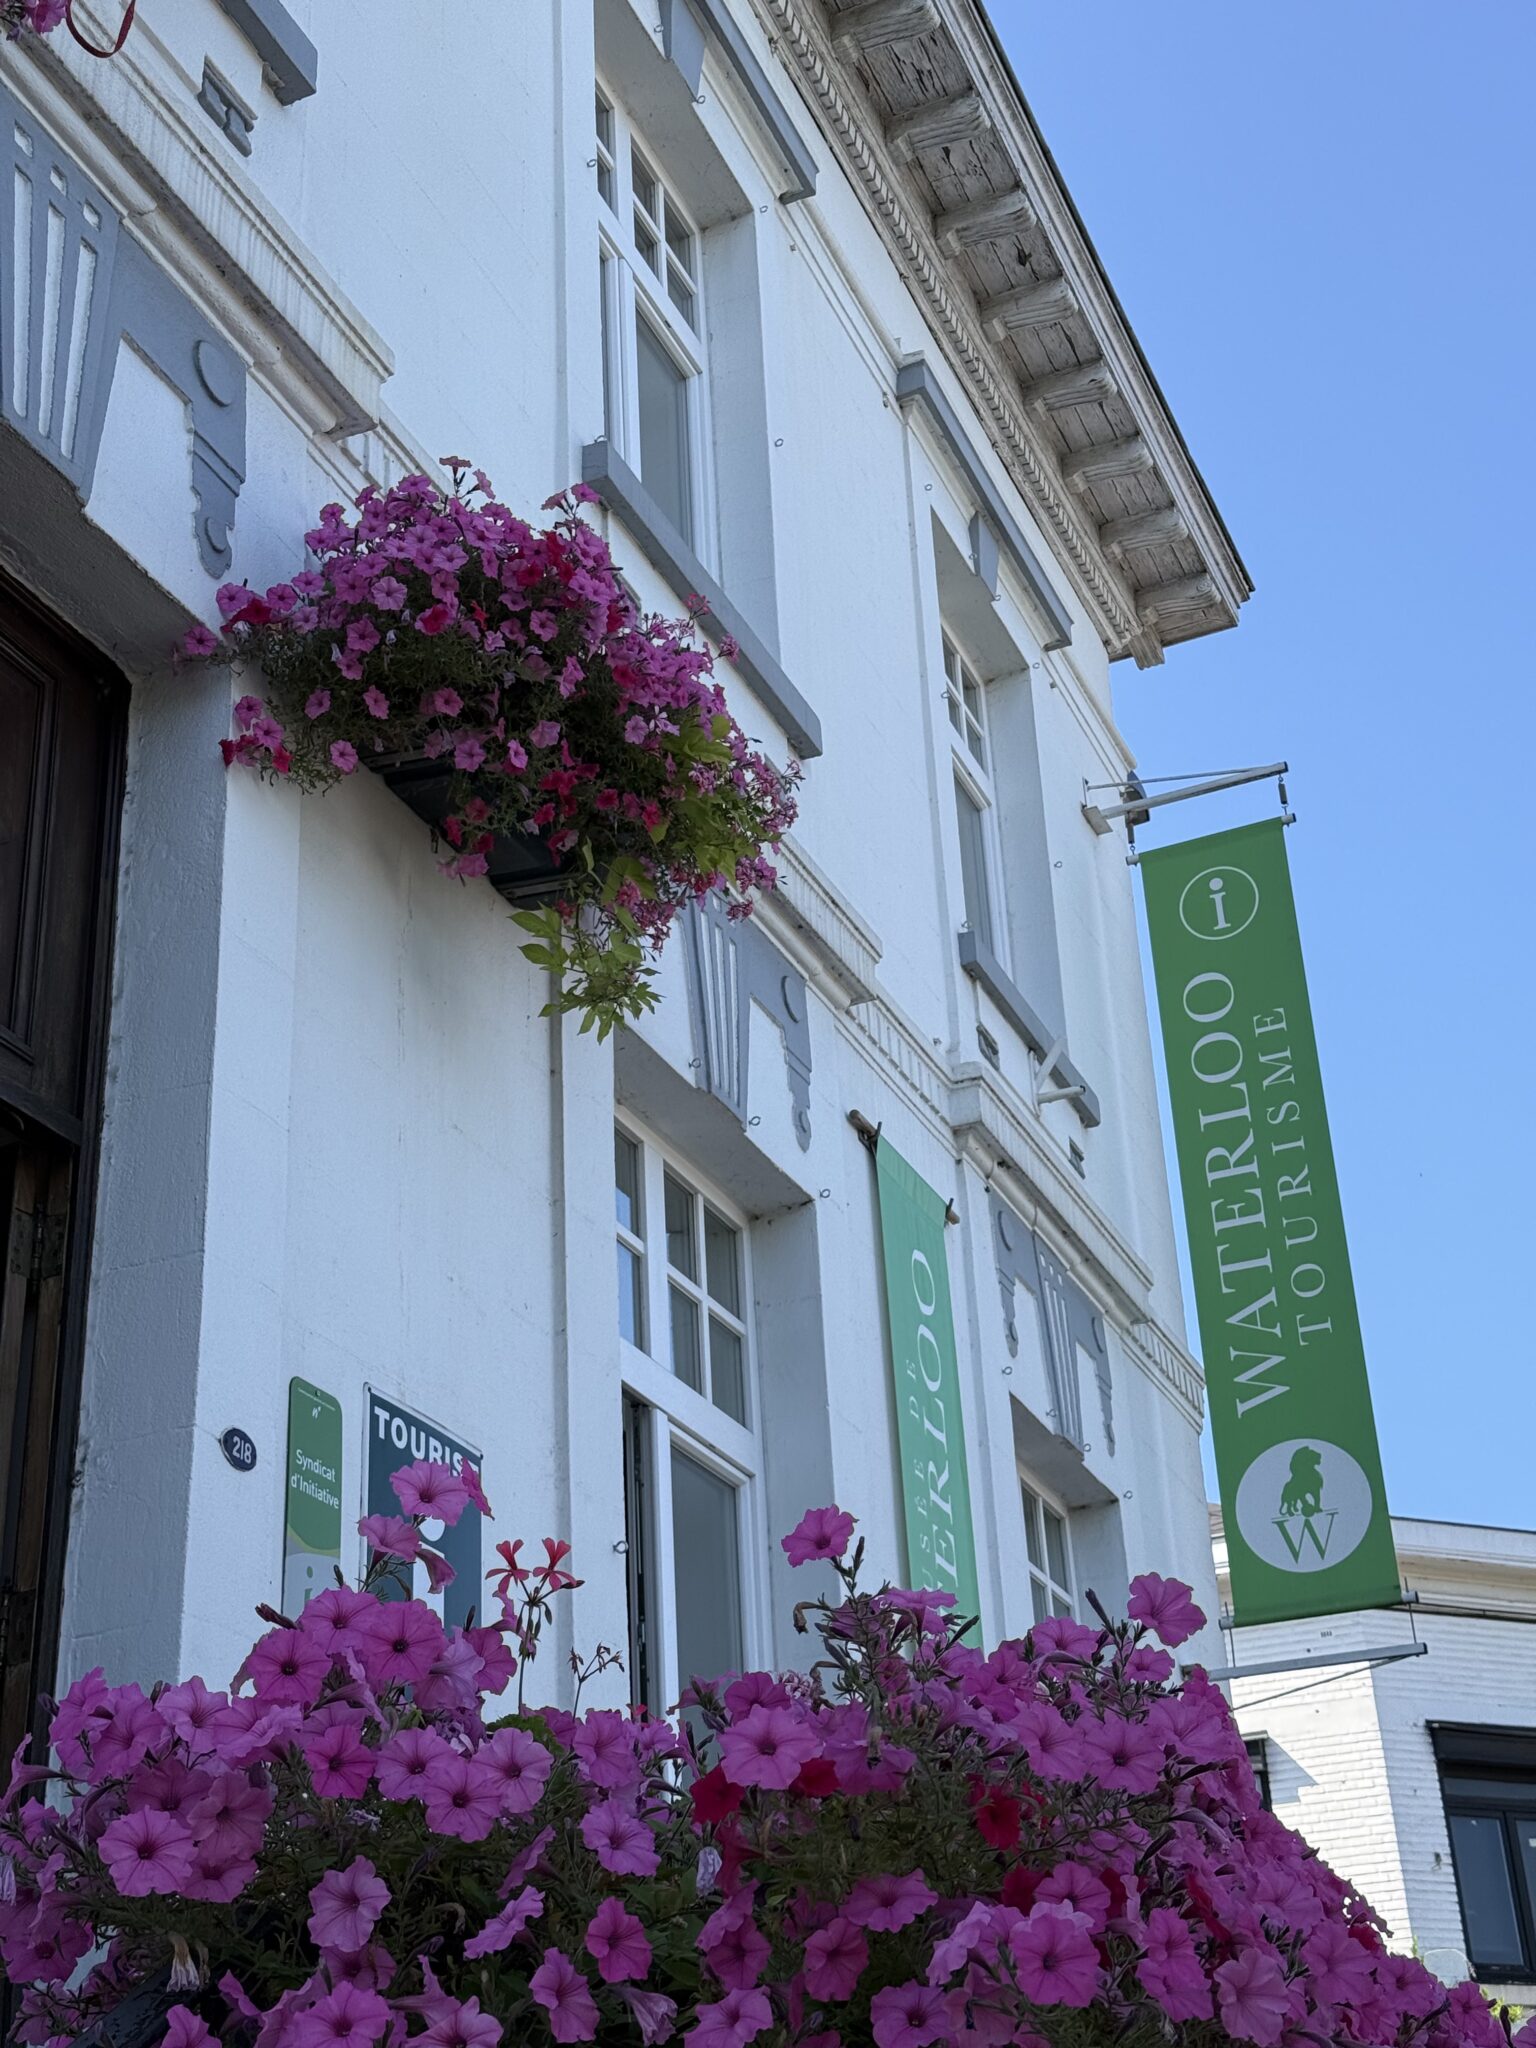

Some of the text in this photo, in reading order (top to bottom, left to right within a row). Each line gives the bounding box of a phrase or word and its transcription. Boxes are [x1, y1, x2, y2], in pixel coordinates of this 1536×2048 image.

[1209, 877, 1232, 931] i
[1182, 971, 1291, 1419] WATERLOO
[1252, 1006, 1333, 1347] TOURISME
[911, 1249, 959, 1592] ERLOO
[231, 1435, 253, 1465] 218
[295, 1448, 337, 1483] Syndicat
[905, 1359, 934, 1592] USÉE DE
[290, 1472, 340, 1510] d'Initiative
[1271, 1511, 1340, 1565] W
